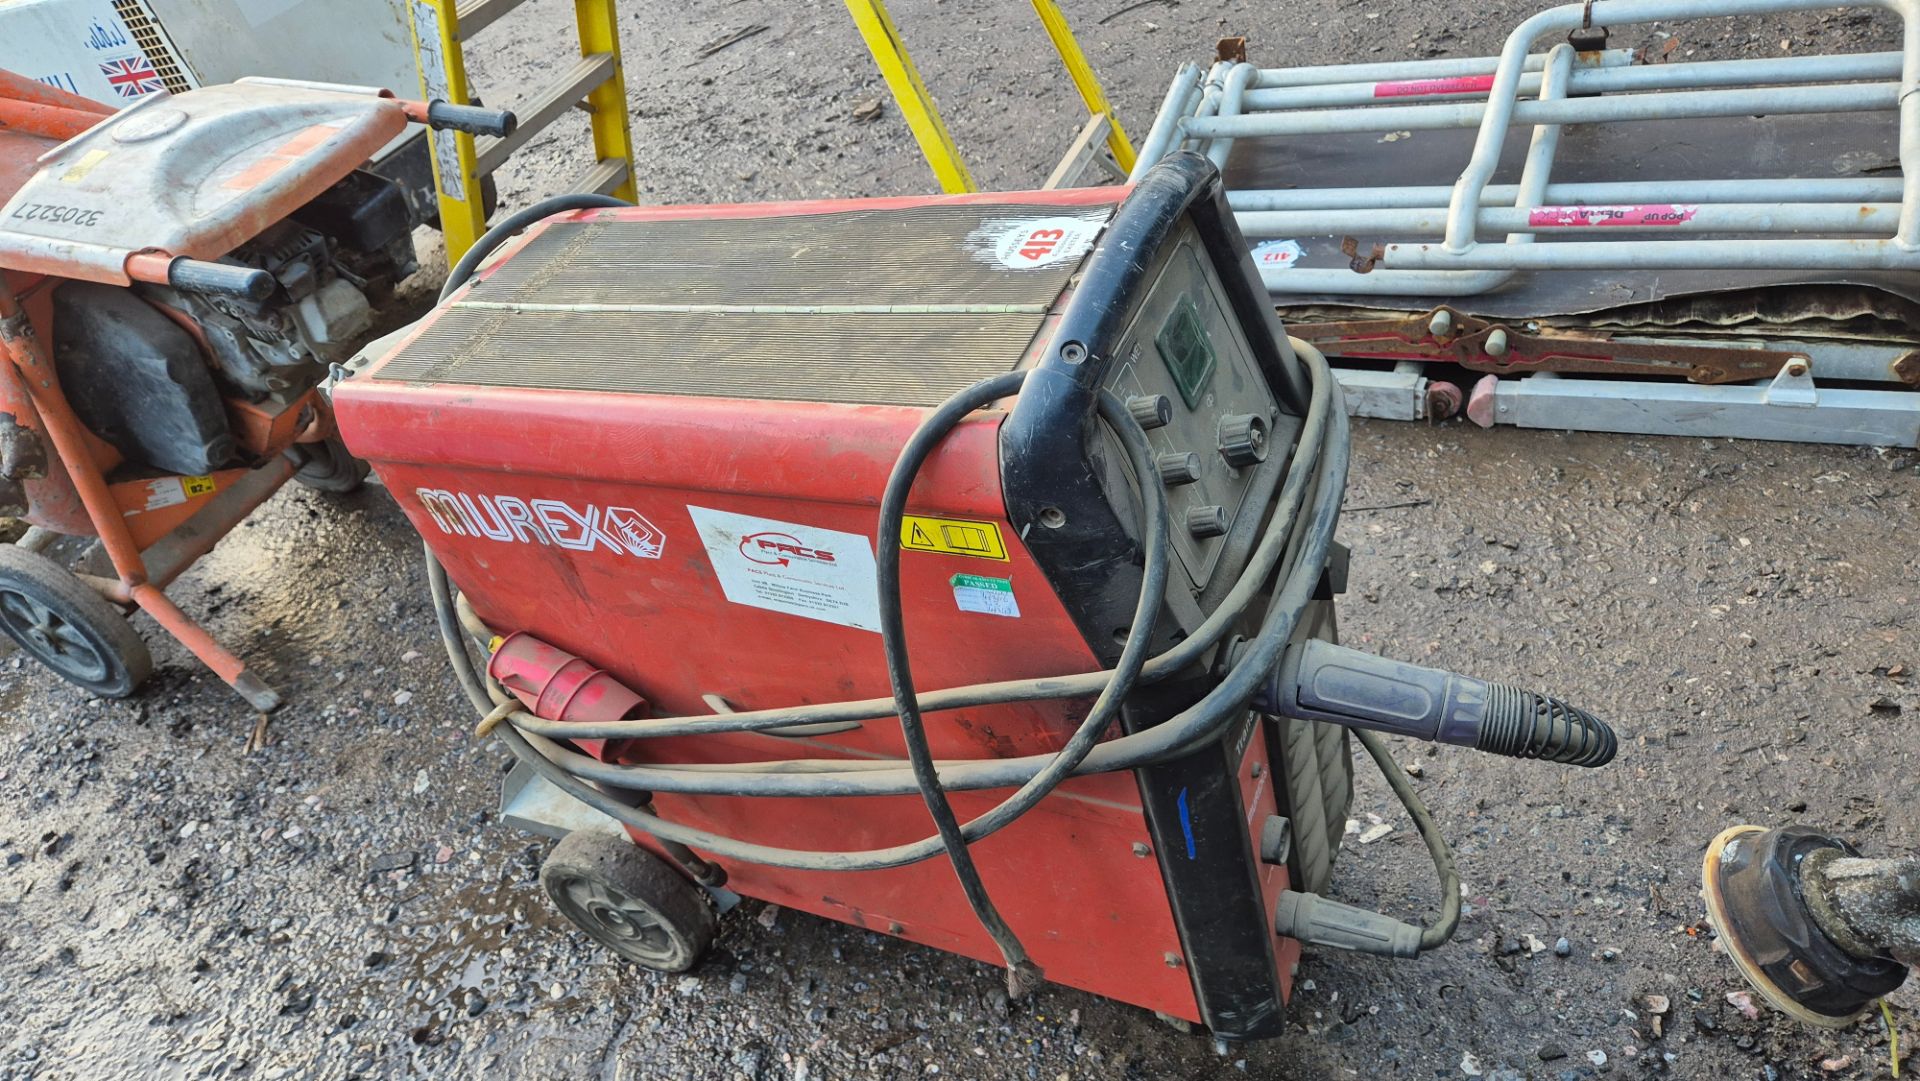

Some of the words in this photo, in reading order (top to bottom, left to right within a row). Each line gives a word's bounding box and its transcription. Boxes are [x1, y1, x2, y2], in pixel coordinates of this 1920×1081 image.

[1397, 86, 1408, 95] DO
[1410, 85, 1426, 94] NOT
[11, 202, 105, 227] 3205227
[1661, 212, 1684, 221] POP
[1018, 228, 1064, 260] 413
[416, 487, 624, 556] MUREX
[757, 539, 836, 562] PACS
[963, 579, 998, 589] PASSED
